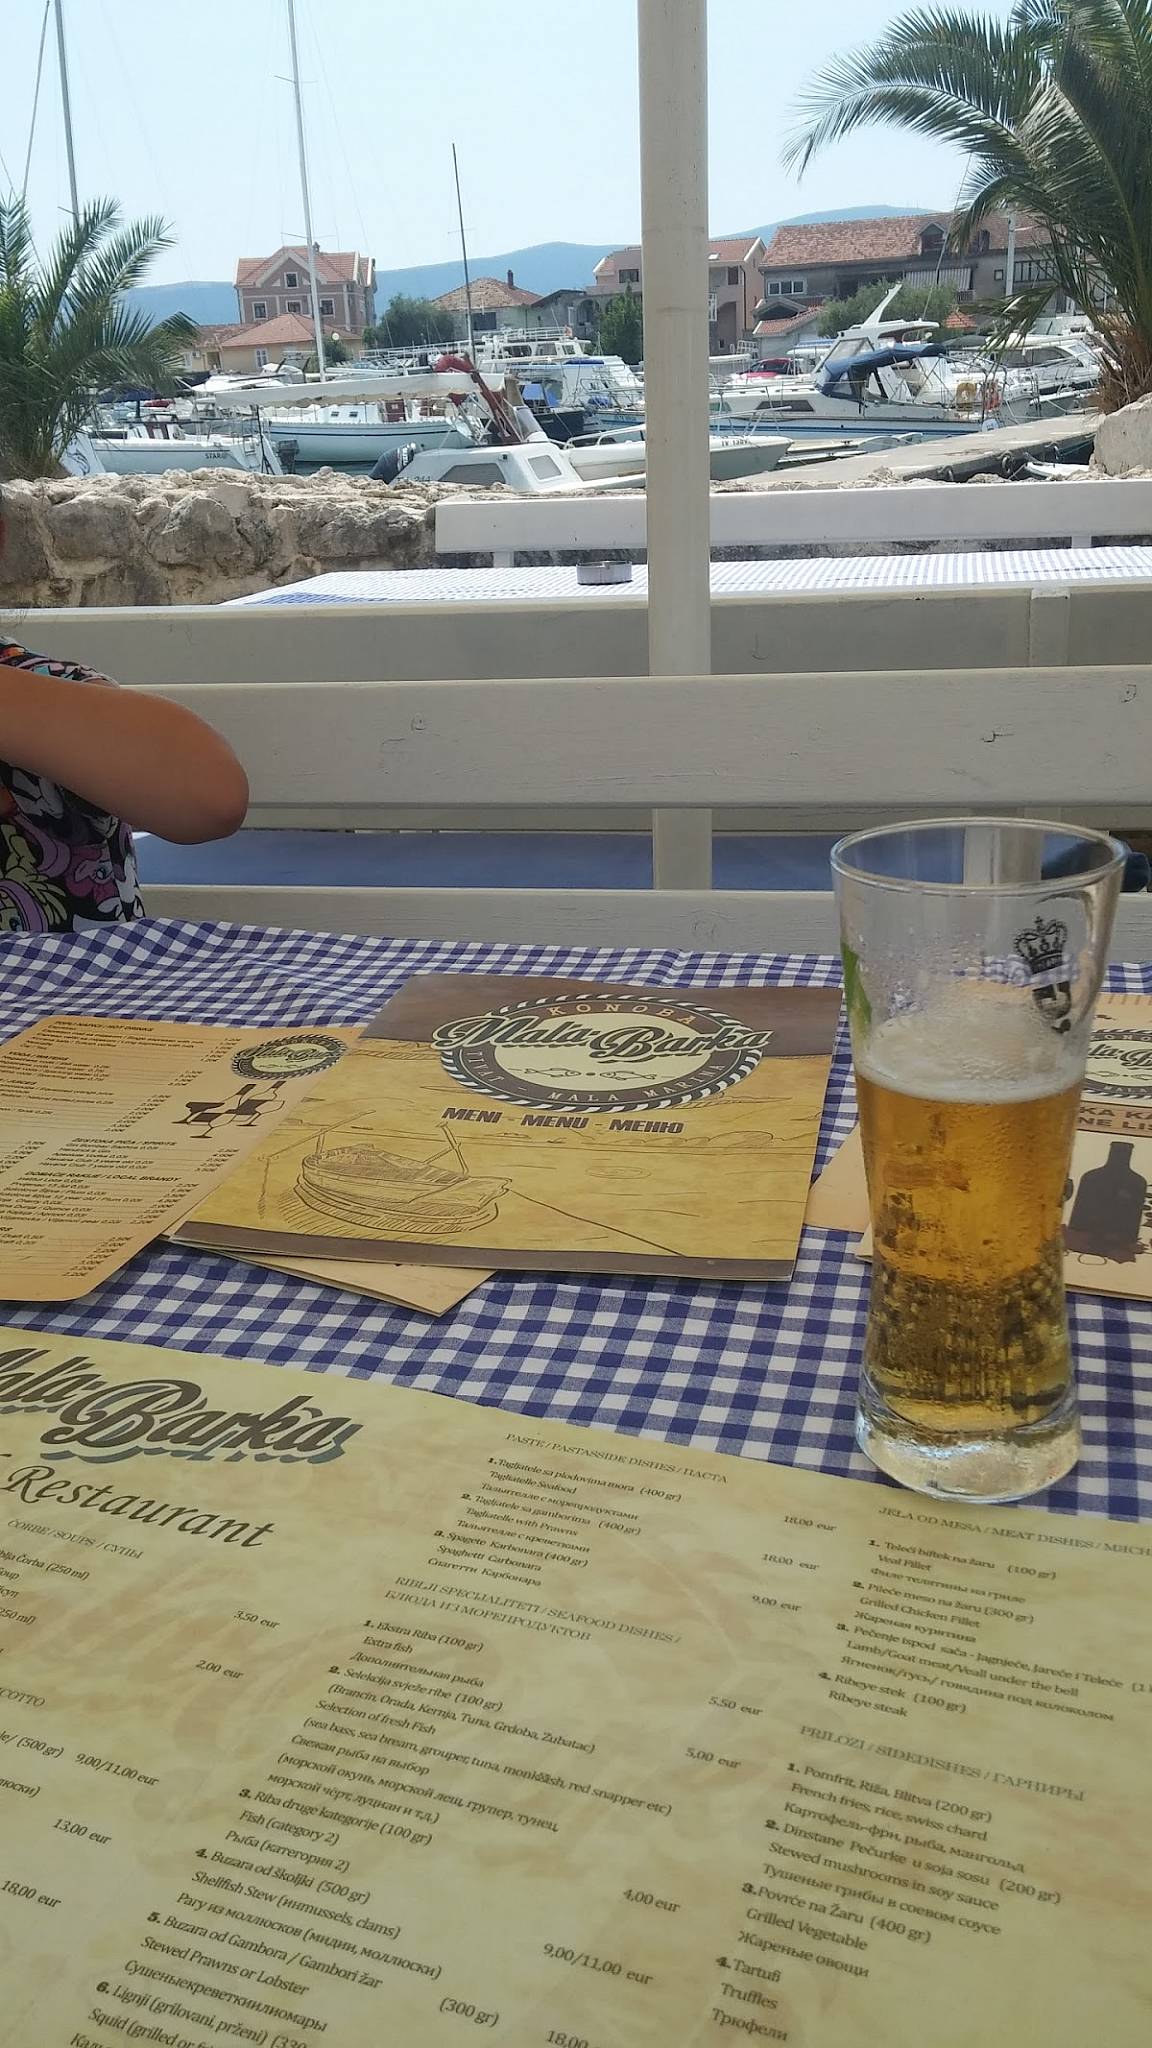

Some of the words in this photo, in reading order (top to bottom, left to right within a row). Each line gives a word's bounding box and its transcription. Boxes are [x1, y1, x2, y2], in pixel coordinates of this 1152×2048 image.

[546, 1003, 696, 1025] KONOBA
[431, 1013, 594, 1050] Mala
[589, 1025, 775, 1064] Barka
[547, 1091, 619, 1103] MALA
[642, 1064, 725, 1099] MARINA
[441, 1106, 503, 1124] MENI
[520, 1114, 589, 1129] MENU
[608, 1118, 685, 1134] МЕНЮ
[40, 1378, 363, 1464] Barka
[0, 1465, 276, 1548] Restaurant
[362, 1635, 392, 1649] Extra
[376, 1621, 411, 1636] Ekstra
[343, 1668, 391, 1686] Selekcija
[391, 1680, 427, 1693] svježe
[454, 1692, 484, 1706] (100
[315, 1700, 366, 1718] Selection
[379, 1714, 410, 1728] fresh
[327, 1683, 377, 1702] (Brancin,
[379, 1694, 415, 1711] Orada,
[461, 1712, 491, 1728] Tuna,
[541, 1732, 595, 1754] Zubatac)
[75, 1753, 138, 1779] 9,00/11,00
[328, 1721, 356, 1737] bass,
[378, 1733, 418, 1752] bream,
[418, 1746, 470, 1764] grouper,
[470, 1756, 500, 1772] tuna,
[591, 1789, 645, 1807] snapper
[685, 1747, 714, 1762] 5,00
[53, 1818, 88, 1836] 13,00
[239, 1809, 265, 1825] Fish
[265, 1817, 324, 1842] (category
[253, 1791, 282, 1806] Riba
[282, 1798, 318, 1815] druge
[318, 1806, 379, 1830] kategorije
[379, 1822, 412, 1839] (100
[224, 1830, 259, 1847] Рыба
[259, 1839, 333, 1867] (категория
[1, 1880, 37, 1899] 18,00
[210, 1850, 254, 1871] Buzara
[316, 1880, 350, 1896] (500
[191, 1870, 244, 1894] Shellfish
[243, 1885, 277, 1902] Stew
[355, 1917, 401, 1940] clams)
[623, 1889, 654, 1905] 4,00
[176, 1892, 208, 1911] Рагу
[225, 1908, 303, 1936] моллюсков
[360, 1947, 442, 1980] моллюски)
[746, 1907, 795, 1930] Grilled
[798, 1921, 867, 1950] Vegetable
[140, 1936, 191, 1959] Stewed
[189, 1950, 239, 1974] Prawns
[256, 1970, 309, 1995] Lobster
[163, 1915, 208, 1937] Buzara
[227, 1934, 287, 1960] Gambora
[299, 1955, 359, 1981] Gambori
[357, 1972, 383, 1988] žar
[543, 1943, 622, 1975] 9,00/11,00
[734, 1959, 781, 1982] Tartufi
[439, 1997, 476, 2017] (300
[473, 2011, 499, 2028] gr)
[721, 1982, 778, 2009] Truffles
[88, 2008, 130, 2031] Squid
[126, 2020, 182, 2047] (grilled
[112, 1984, 152, 2007] Lignji
[148, 1997, 216, 2029] (grilovani,
[214, 2020, 268, 2046] prženi)
[712, 2007, 787, 2041] Трюфели
